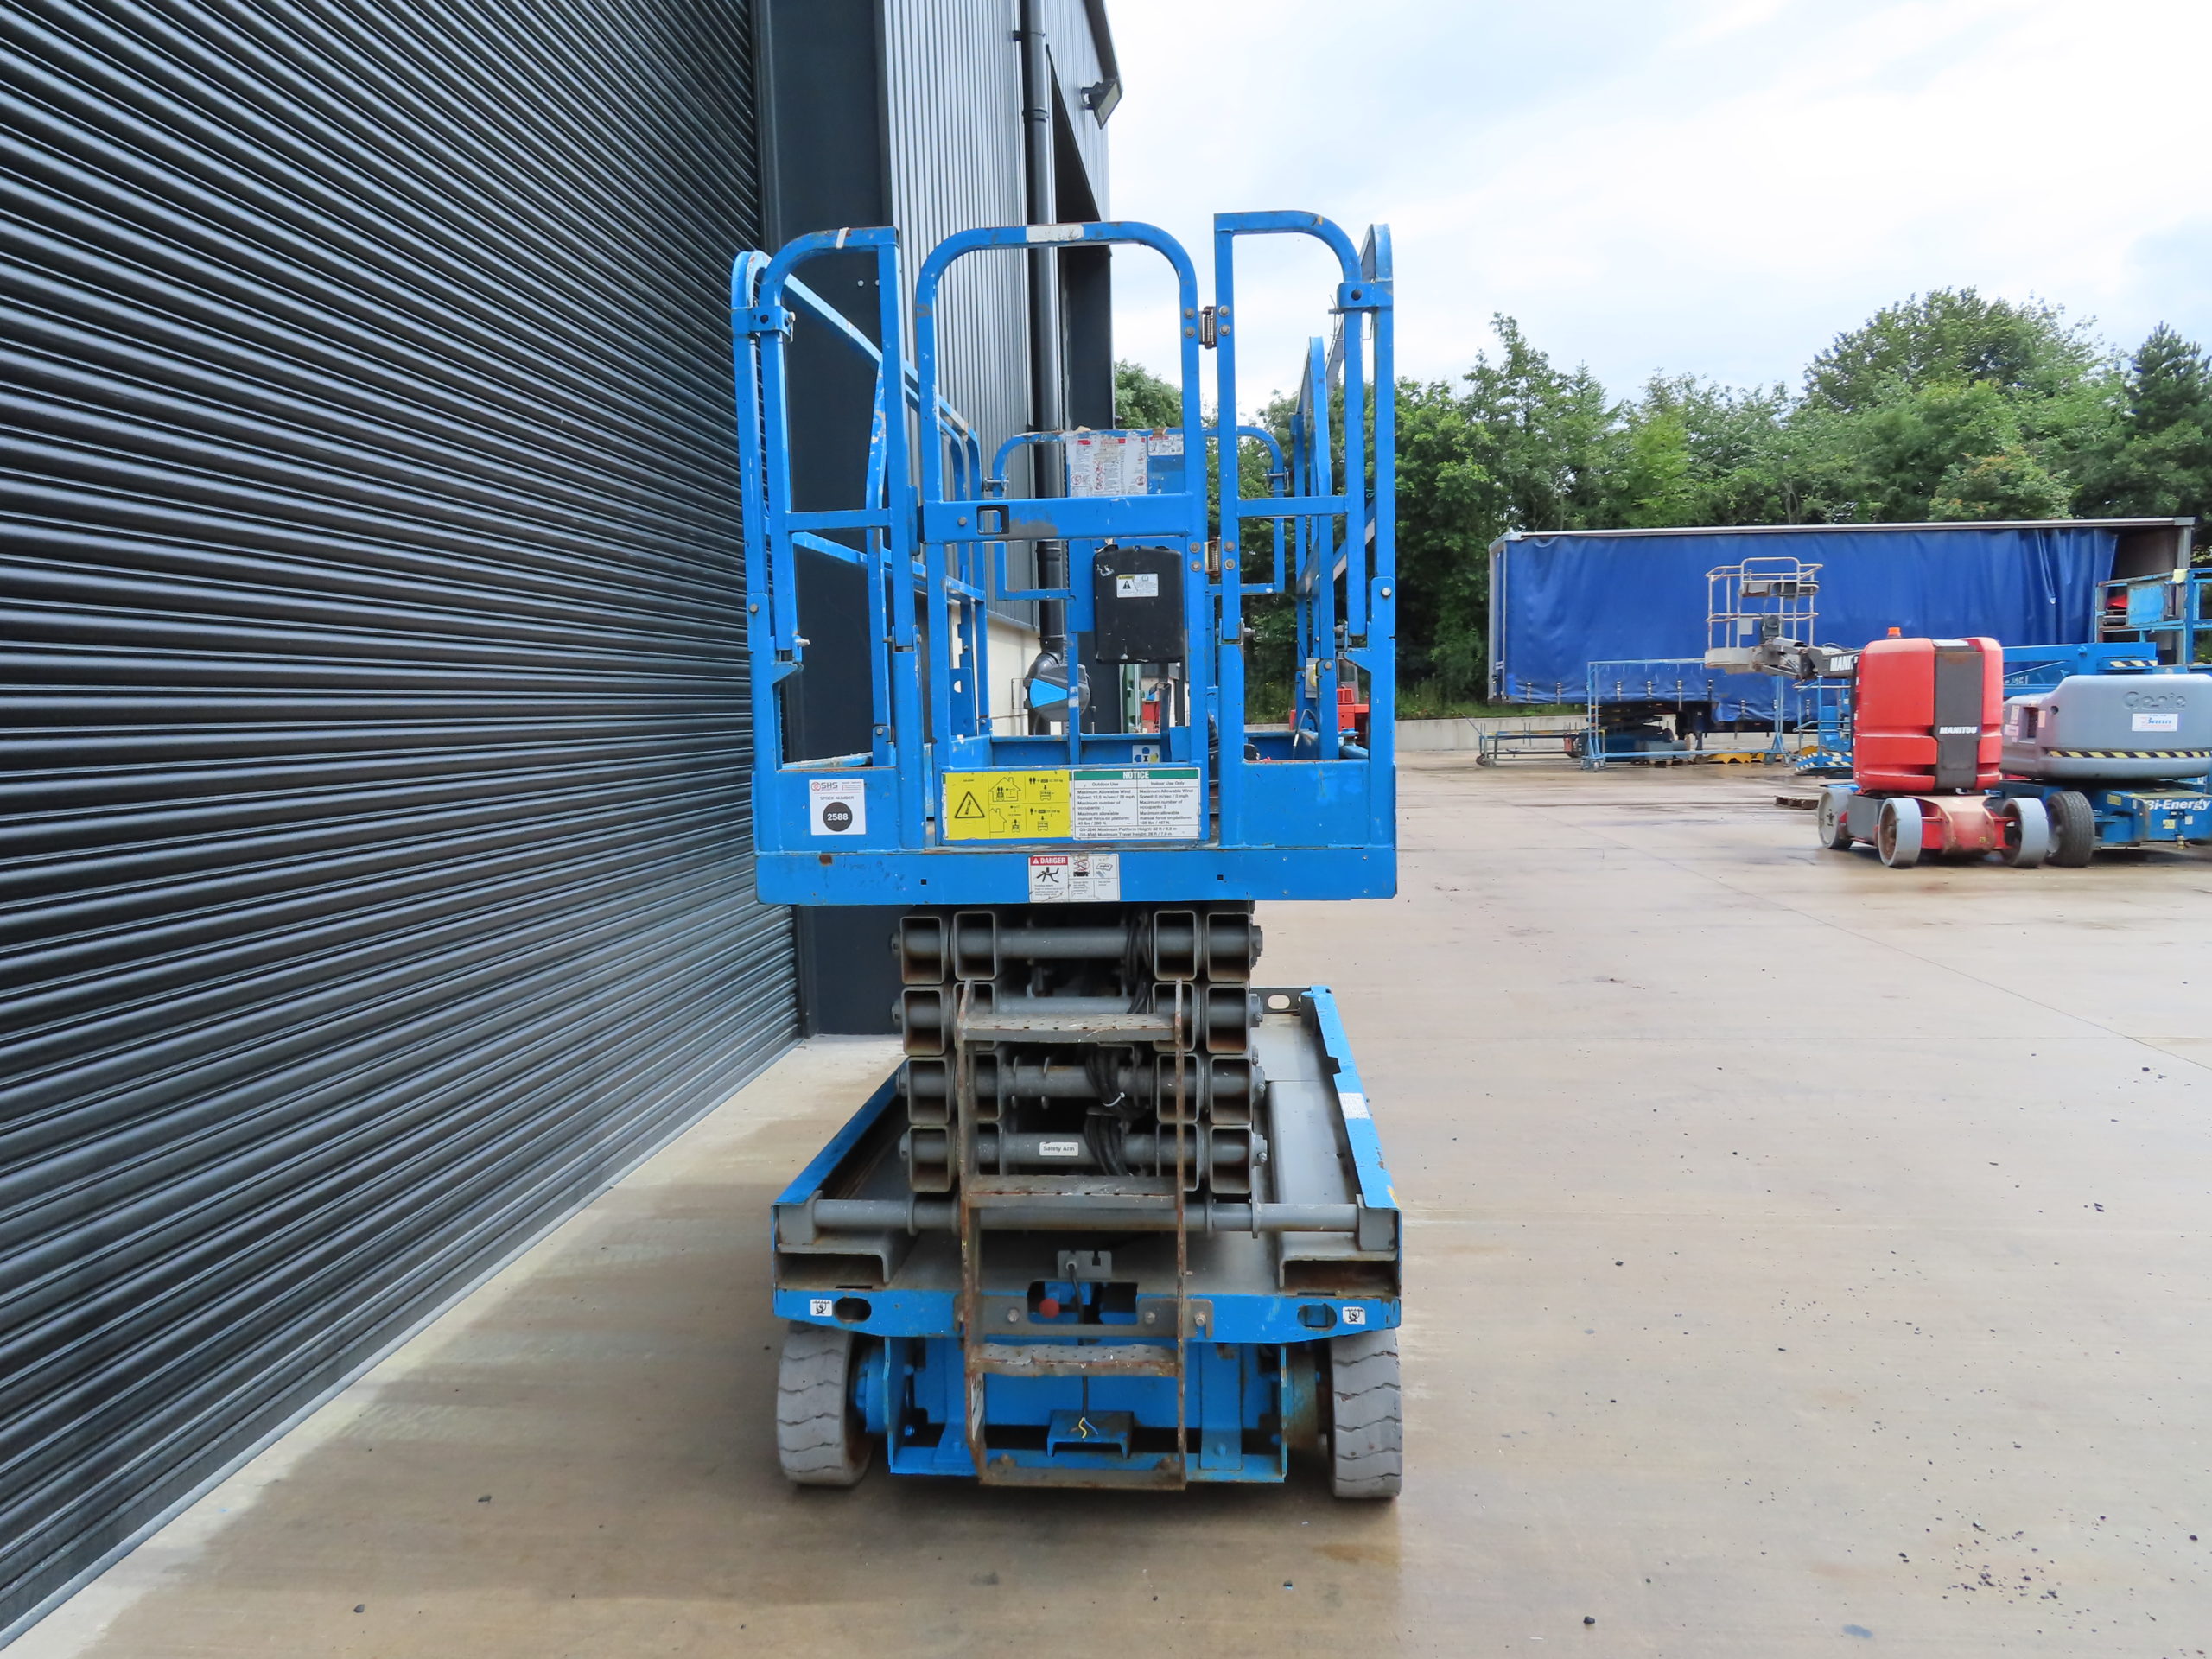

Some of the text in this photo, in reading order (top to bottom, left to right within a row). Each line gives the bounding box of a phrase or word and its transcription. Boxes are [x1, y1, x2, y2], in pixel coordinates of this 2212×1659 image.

[2124, 691, 2186, 710] Genie
[1123, 771, 1149, 779] NOTICE
[2146, 799, 2211, 811] Bi-Energy
